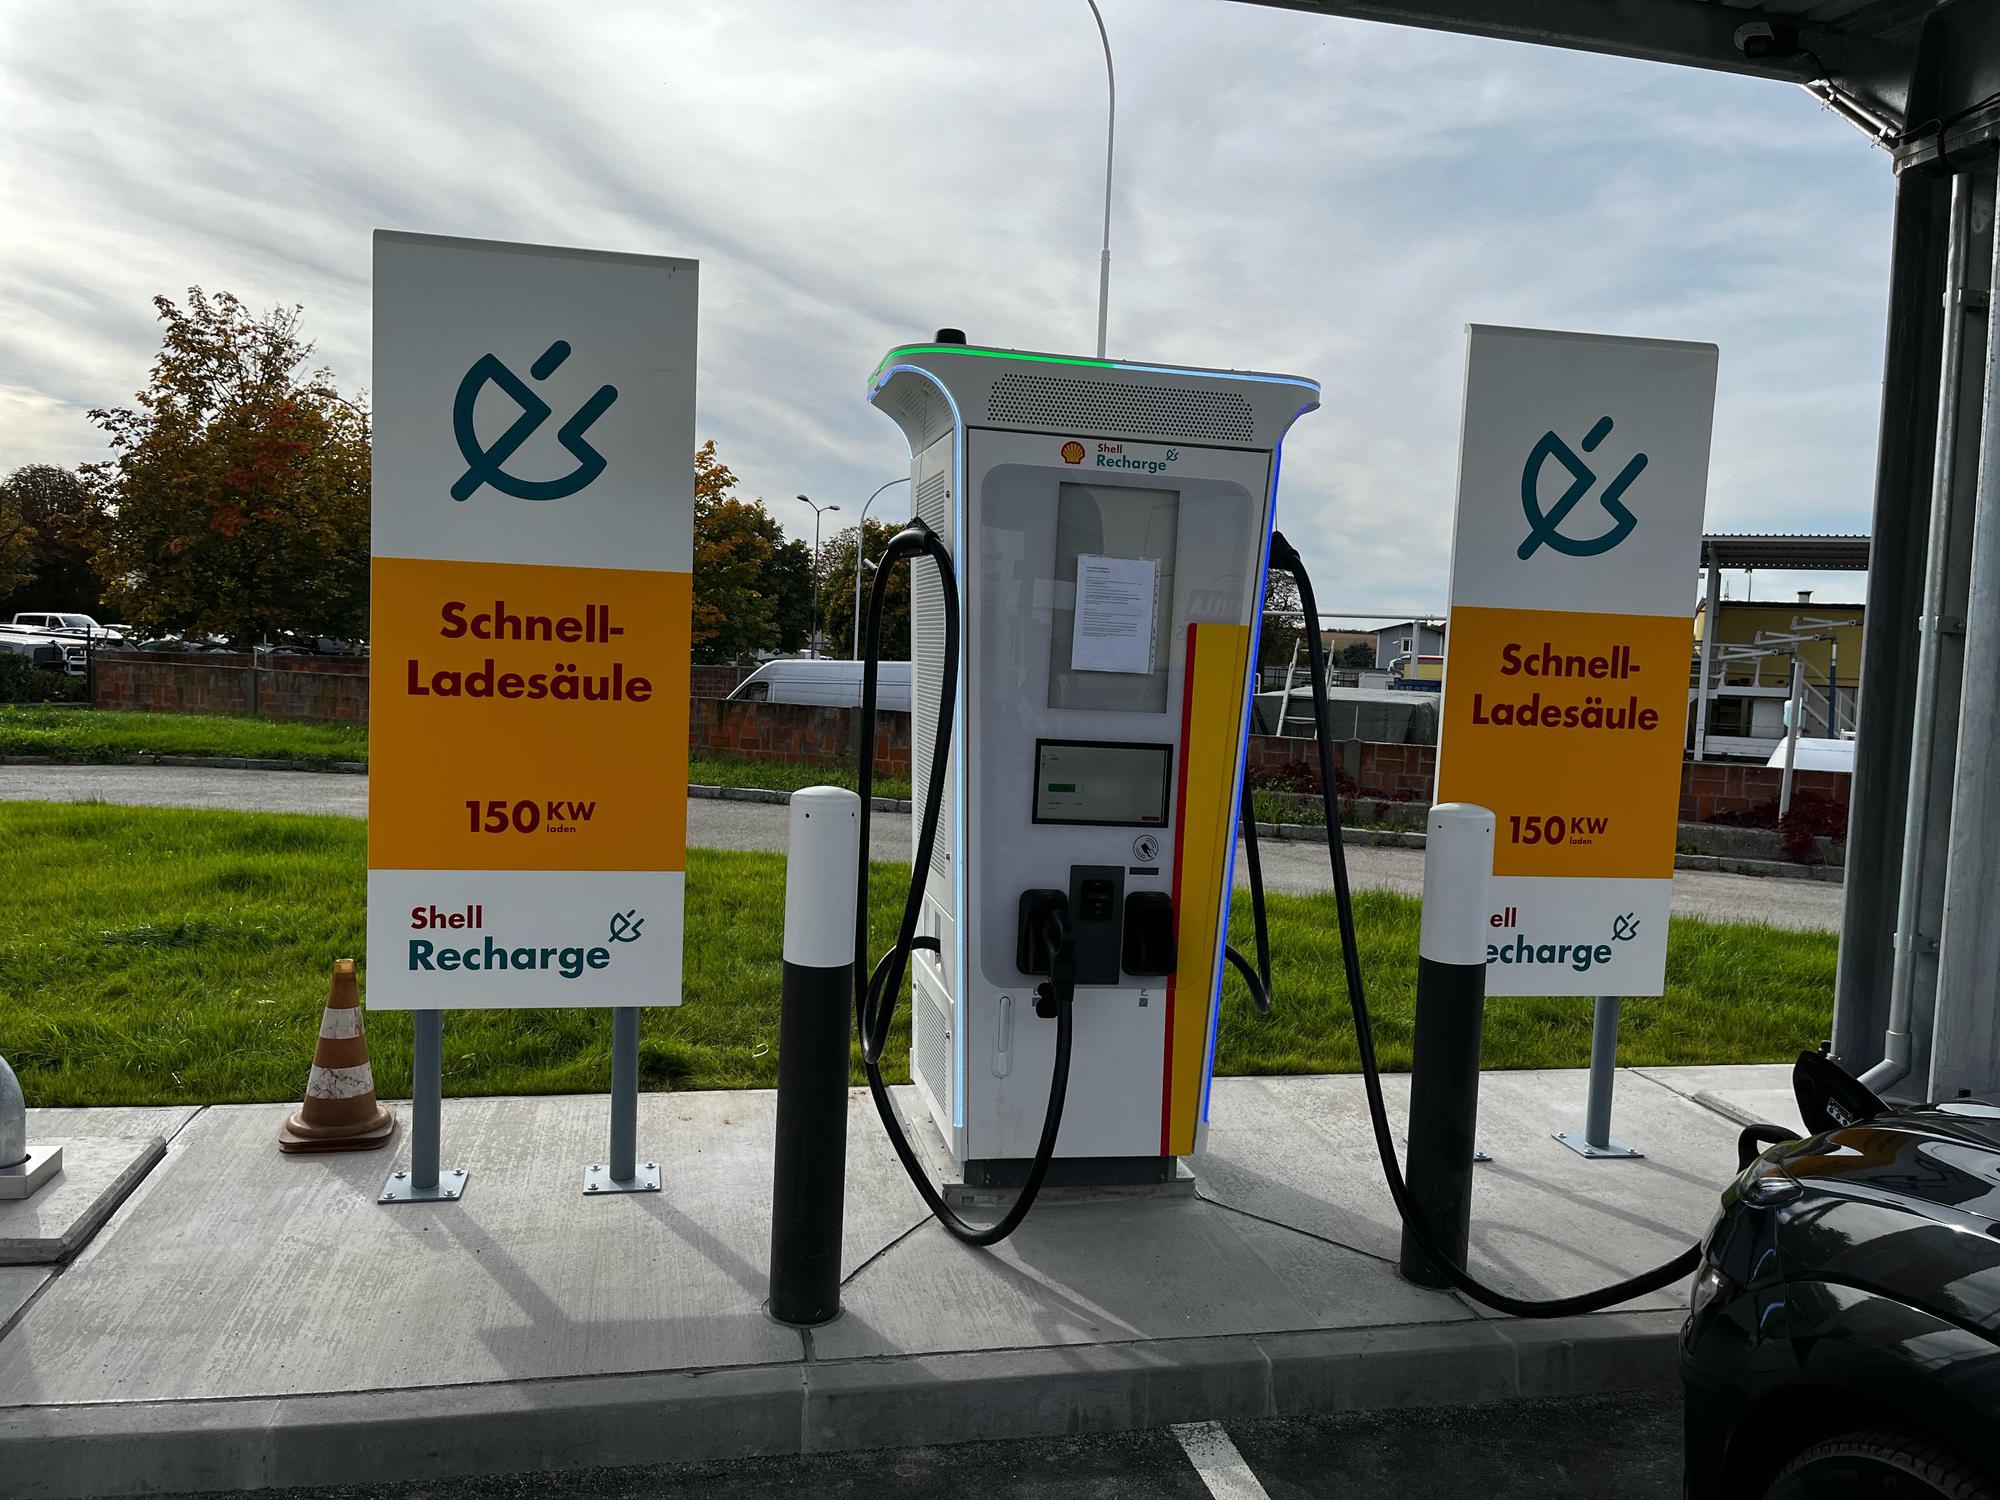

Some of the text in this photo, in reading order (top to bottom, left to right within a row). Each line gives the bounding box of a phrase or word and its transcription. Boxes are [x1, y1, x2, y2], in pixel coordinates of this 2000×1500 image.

[1096, 454, 1166, 473] Recharge
[1097, 443, 1122, 454] Shell
[440, 601, 624, 643] Schnell-
[1501, 643, 1640, 679] Schnell-
[408, 659, 653, 702] Ladesäule
[1473, 693, 1659, 730] Ladesäule
[466, 800, 596, 834] 150 KW
[546, 824, 576, 833] laden
[1509, 816, 1608, 845] 150 KW
[1570, 837, 1592, 845] laden
[411, 905, 482, 929] Shell
[1490, 907, 1517, 928] ell
[409, 937, 610, 979] Recharge
[1486, 934, 1612, 972] echarge
